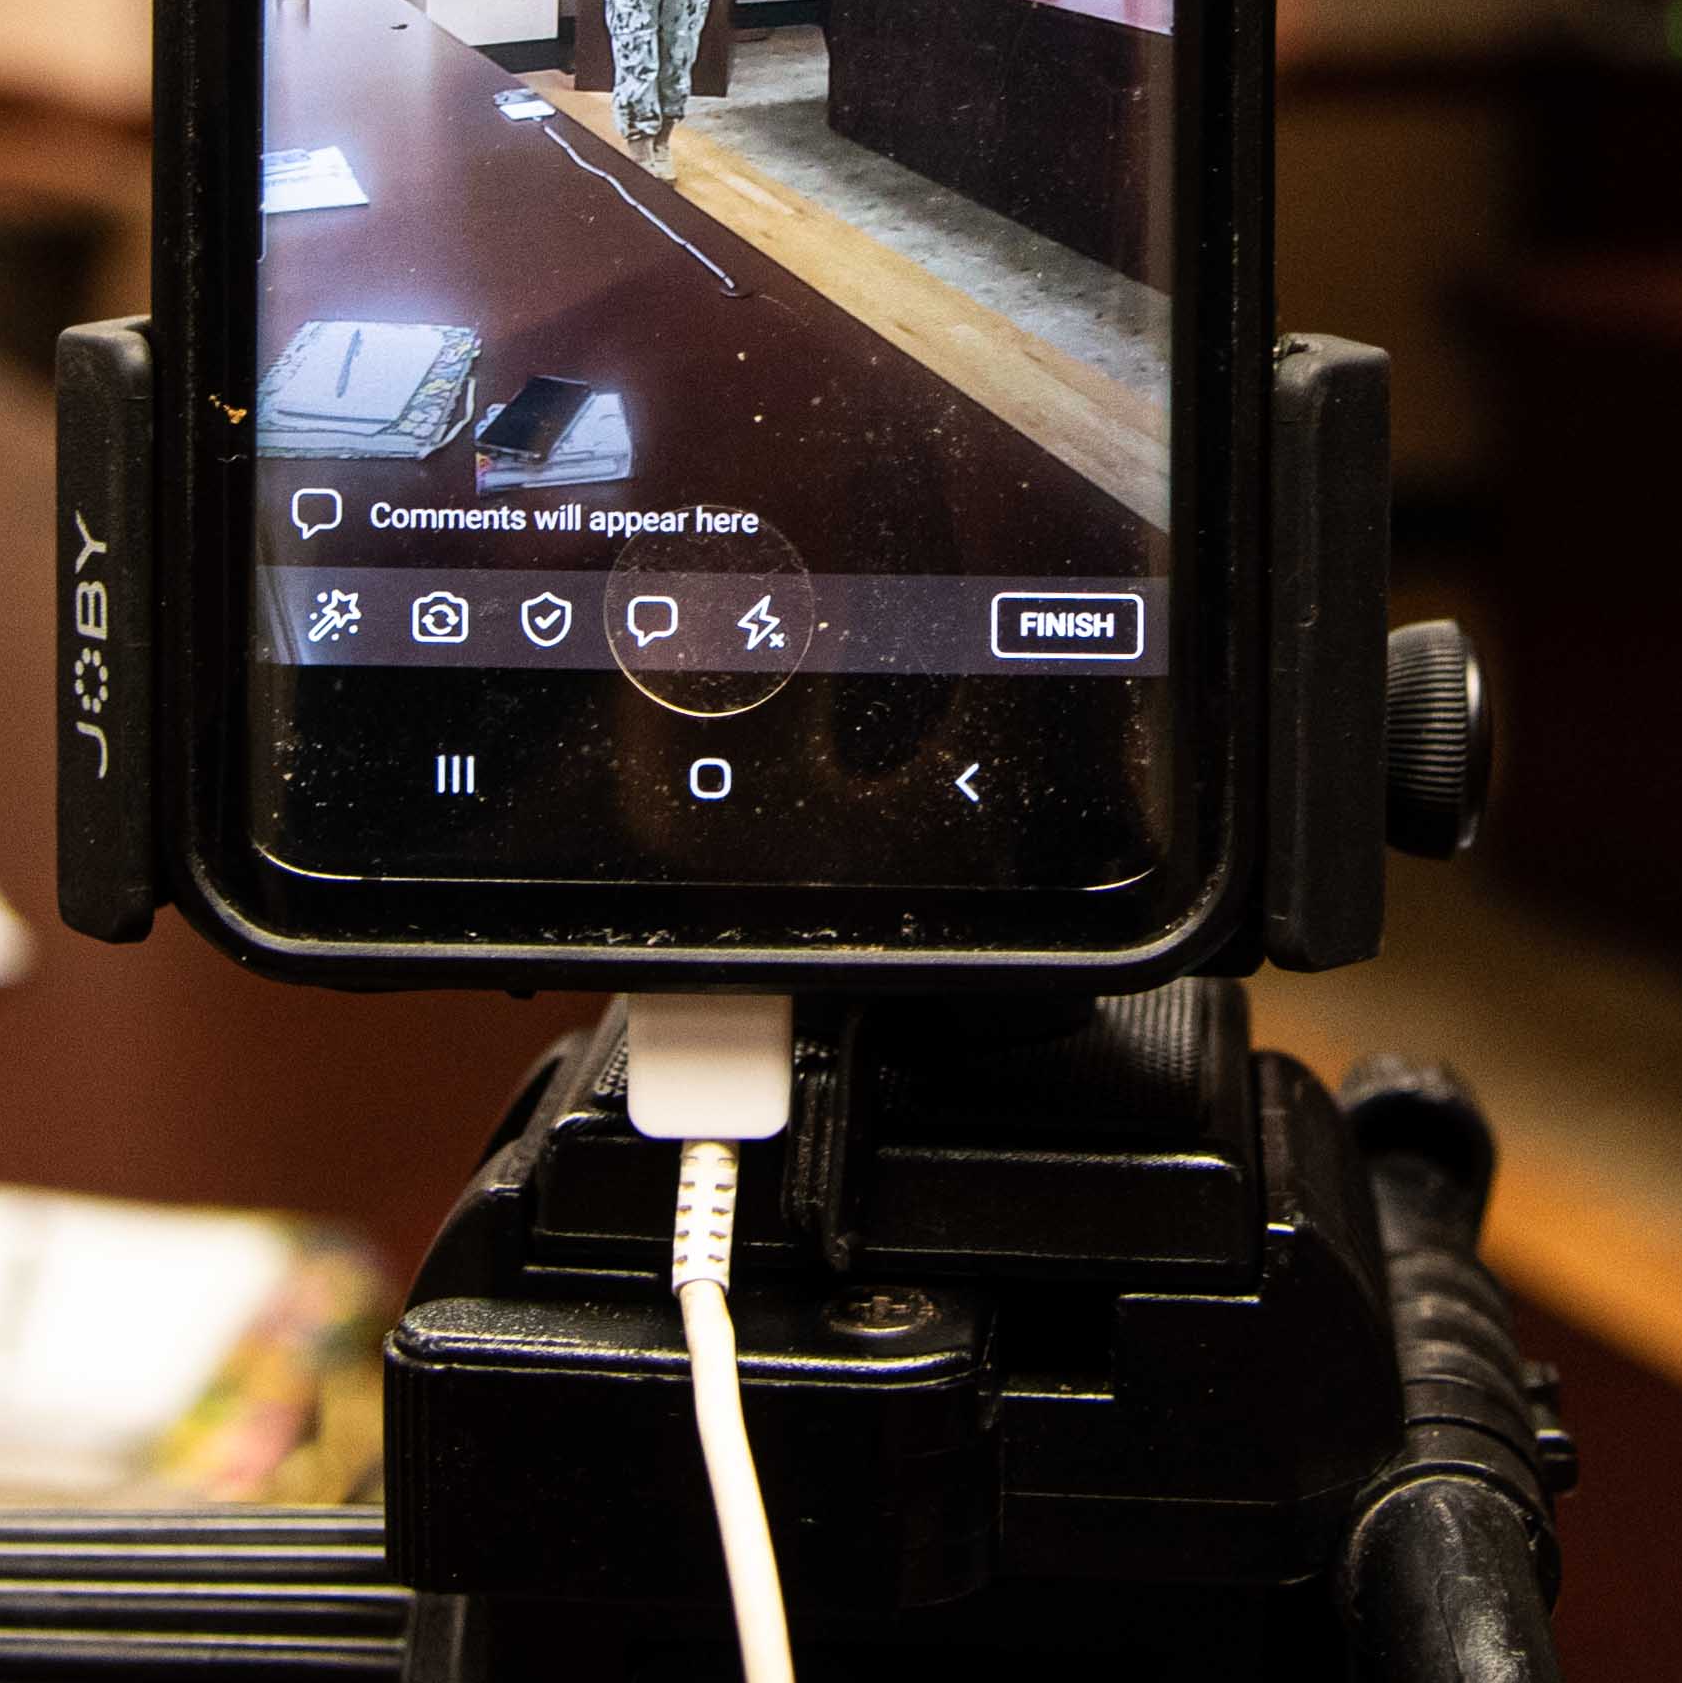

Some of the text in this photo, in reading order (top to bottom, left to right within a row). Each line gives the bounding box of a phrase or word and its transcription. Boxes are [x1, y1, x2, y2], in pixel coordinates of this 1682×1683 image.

[370, 501, 760, 538] Comments will appear here
[1020, 612, 1115, 638] FINISH
[74, 509, 109, 779] JOBY
